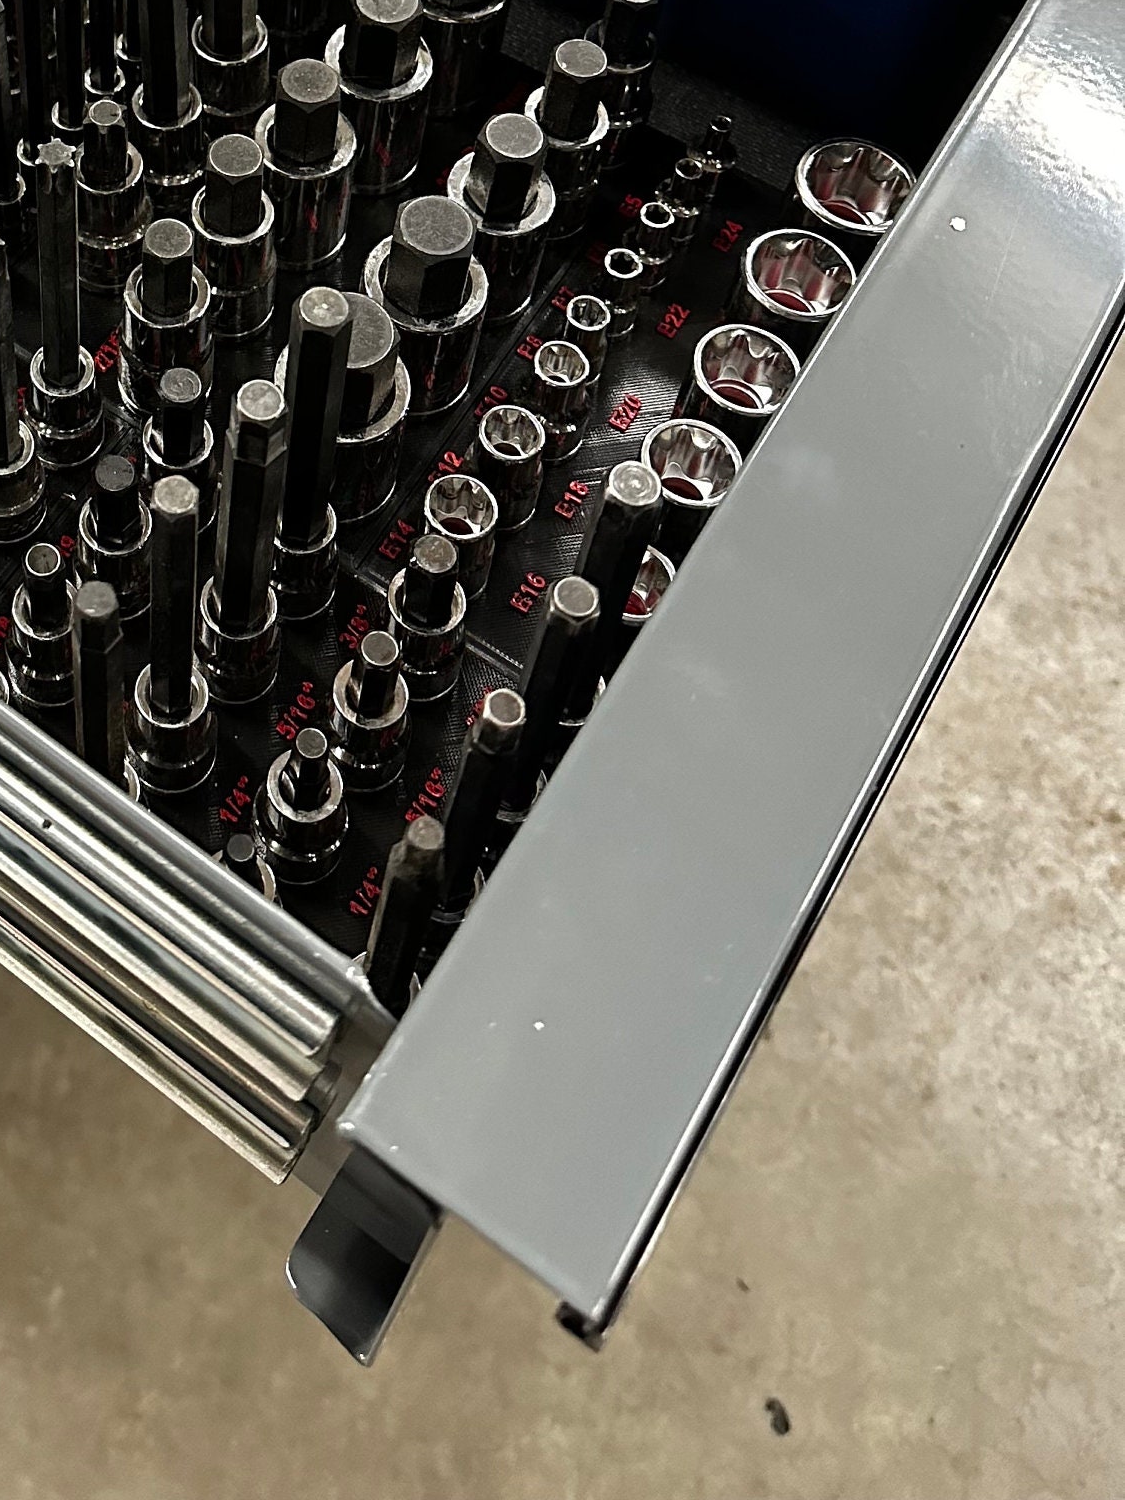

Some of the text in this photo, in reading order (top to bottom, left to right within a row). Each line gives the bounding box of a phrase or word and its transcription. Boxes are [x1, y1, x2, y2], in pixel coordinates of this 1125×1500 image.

[657, 303, 691, 339] E22
[608, 393, 642, 431] E20
[554, 481, 590, 520] E18
[378, 519, 416, 560] E14
[509, 571, 547, 614] E16
[276, 681, 316, 741] 5/16"
[219, 776, 251, 823] 1/4"
[349, 866, 382, 916] 1/4"
